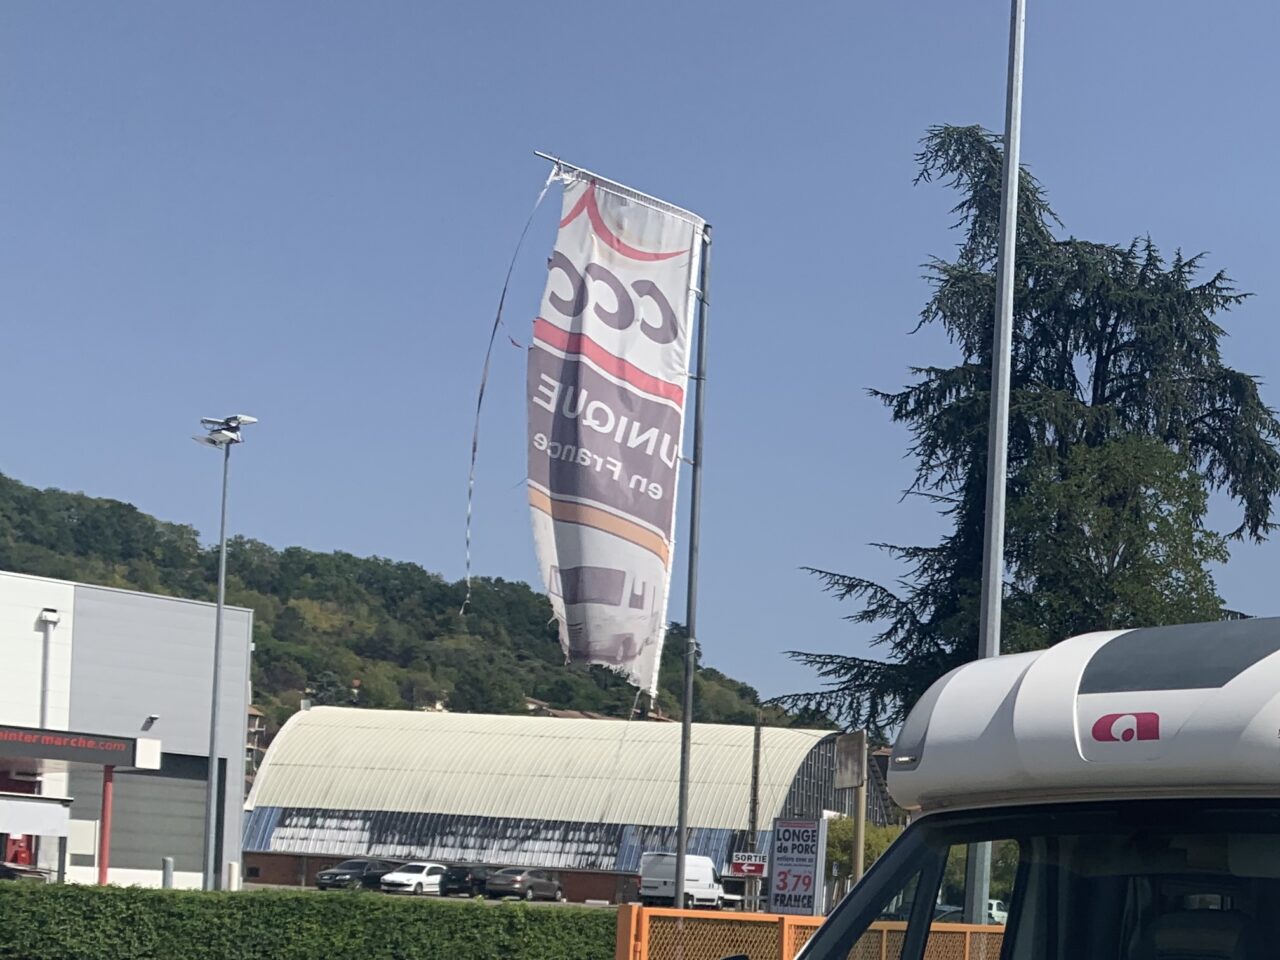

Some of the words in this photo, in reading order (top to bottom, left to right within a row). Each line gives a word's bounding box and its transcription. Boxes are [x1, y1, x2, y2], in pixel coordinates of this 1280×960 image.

[776, 828, 817, 843] LONGE
[791, 843, 816, 855] PORC
[734, 853, 767, 862] SORTIE
[774, 893, 812, 908] FRANCE
